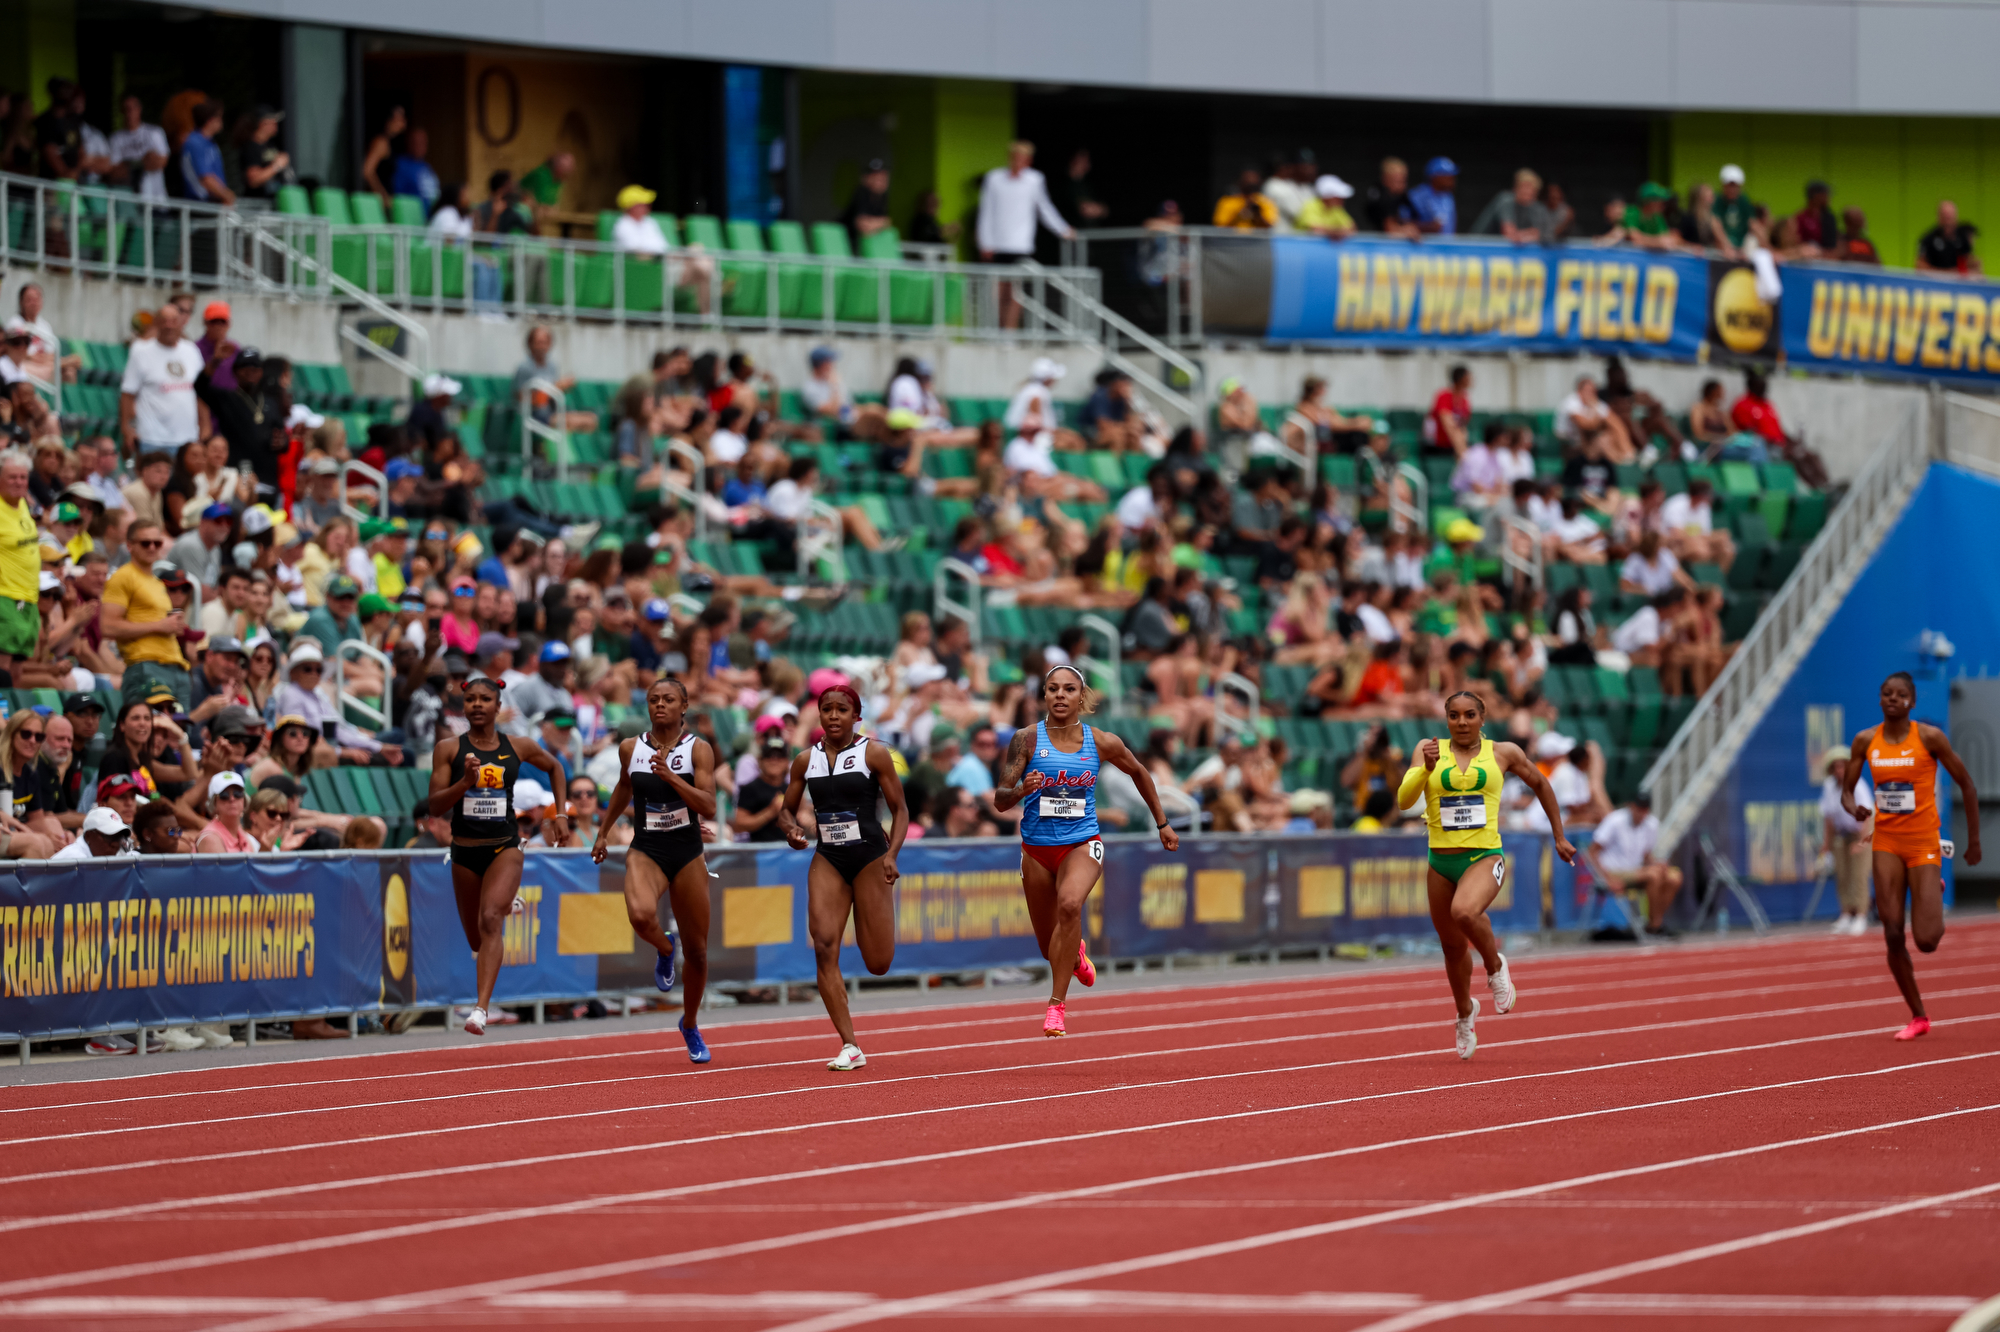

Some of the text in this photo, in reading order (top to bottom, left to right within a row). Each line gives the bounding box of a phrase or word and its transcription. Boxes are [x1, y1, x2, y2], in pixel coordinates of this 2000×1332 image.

[1335, 254, 1679, 344] HAYWARD FIELD
[1871, 757, 1915, 768] TENNESSEE
[472, 807, 498, 815] CARTER
[1054, 806, 1072, 814] LONG
[654, 818, 682, 828] JAMISON
[1454, 815, 1472, 824] MAYS
[830, 832, 847, 841] FORD
[1094, 841, 1102, 861] 6
[0, 893, 315, 997] RACK AND FIELD CHAMPIONSHIPS
